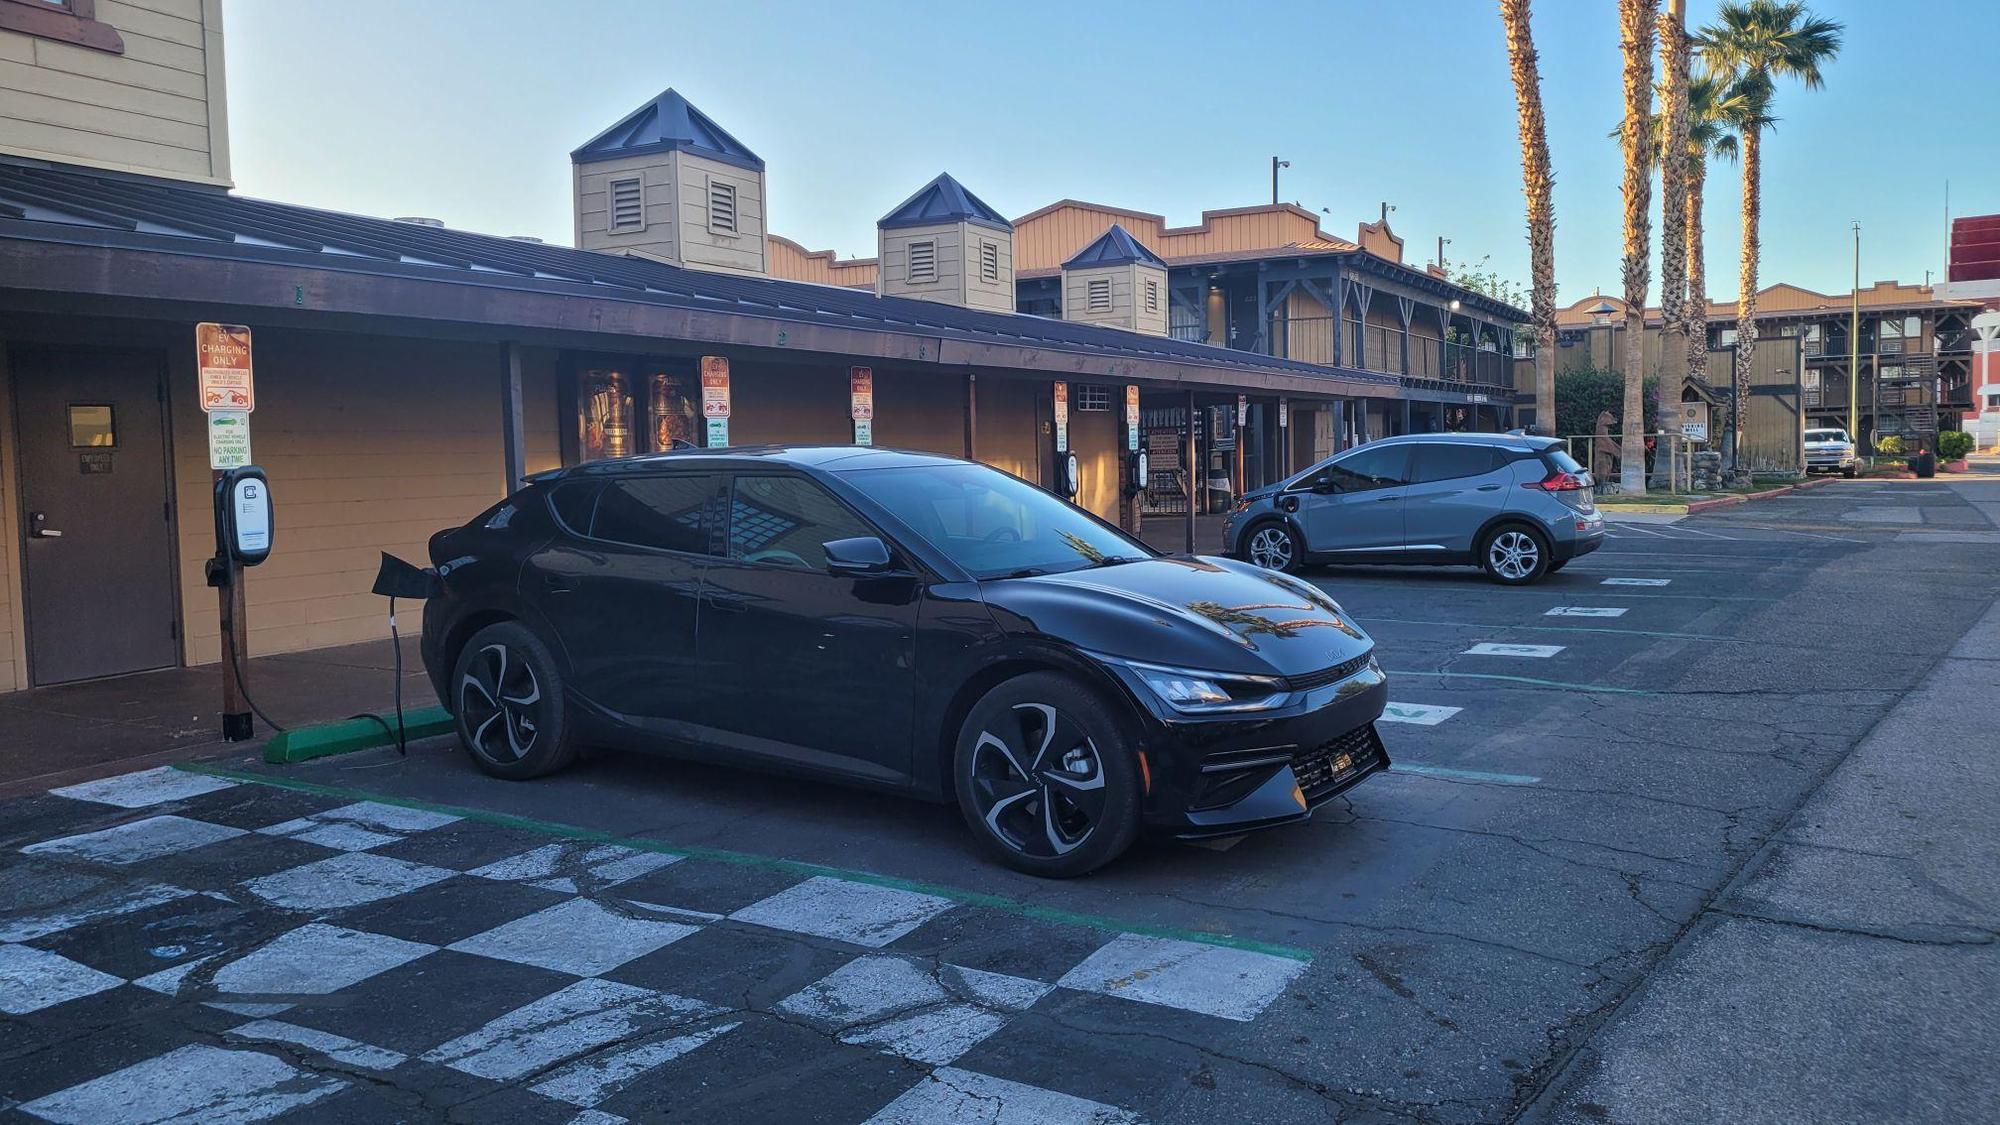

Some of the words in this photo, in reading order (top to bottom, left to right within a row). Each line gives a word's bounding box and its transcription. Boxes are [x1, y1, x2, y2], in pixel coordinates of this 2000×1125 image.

[218, 333, 230, 341] EV
[201, 344, 247, 355] CHARGING
[213, 356, 237, 365] ONLY
[704, 370, 727, 378] CHARGING
[213, 446, 222, 454] NO
[223, 446, 247, 455] PARKING
[218, 455, 230, 464] ANY
[230, 455, 244, 464] TIME
